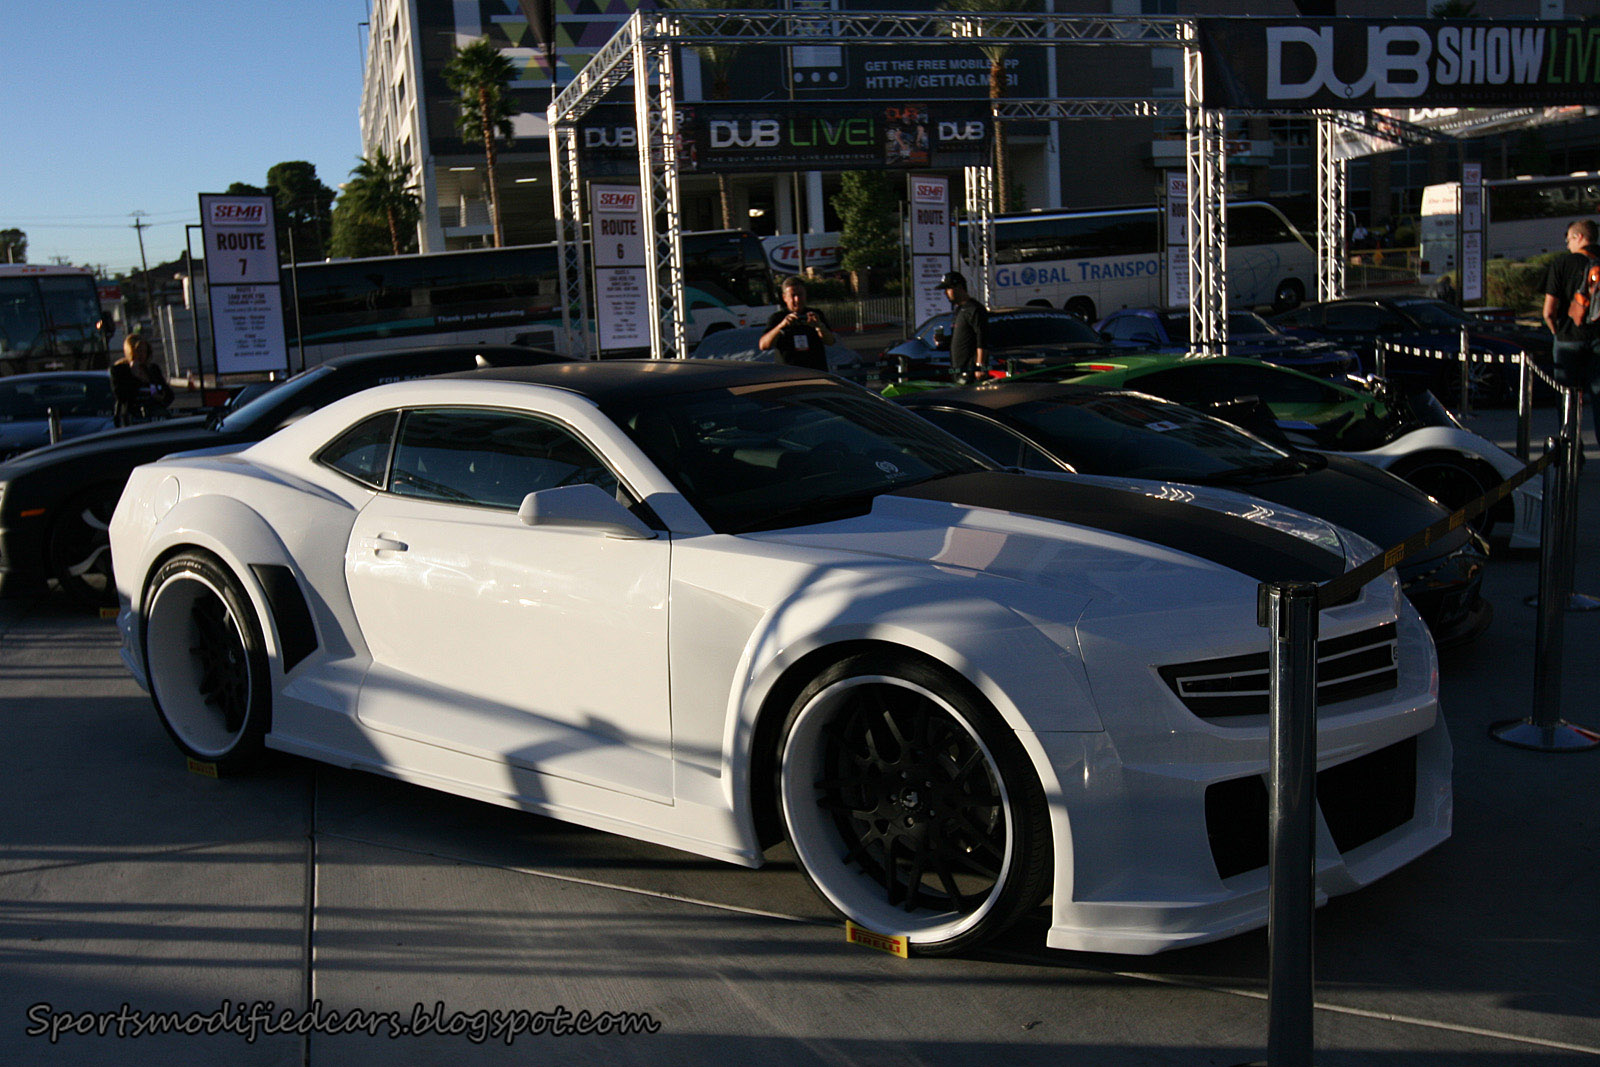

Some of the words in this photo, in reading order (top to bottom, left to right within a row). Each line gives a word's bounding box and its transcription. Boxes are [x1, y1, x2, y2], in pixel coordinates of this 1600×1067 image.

[864, 61, 888, 72] GET
[892, 60, 914, 71] THE
[917, 60, 947, 70] FREE
[949, 59, 992, 70] MOBILE
[995, 58, 1019, 69] PP
[1265, 25, 1433, 100] DUB
[1435, 26, 1546, 85] SHOW
[865, 73, 1019, 90] HTTP://GETTAG.MBI
[584, 126, 637, 148] DUB
[709, 119, 781, 148] DUB
[789, 118, 875, 147] LIVE!
[938, 120, 985, 141] DUB
[917, 185, 944, 197] SEMA
[1172, 180, 1189, 191] SEM
[600, 193, 636, 205] SEMA
[215, 204, 263, 218] SEMA
[917, 209, 944, 225] ROUTE
[601, 219, 637, 236] ROUTE
[216, 232, 266, 251] ROUTE
[928, 232, 934, 247] 5
[617, 243, 624, 260] 6
[238, 258, 248, 276] 7
[996, 266, 1071, 287] GLOBAL
[851, 927, 901, 953] PIRELLI
